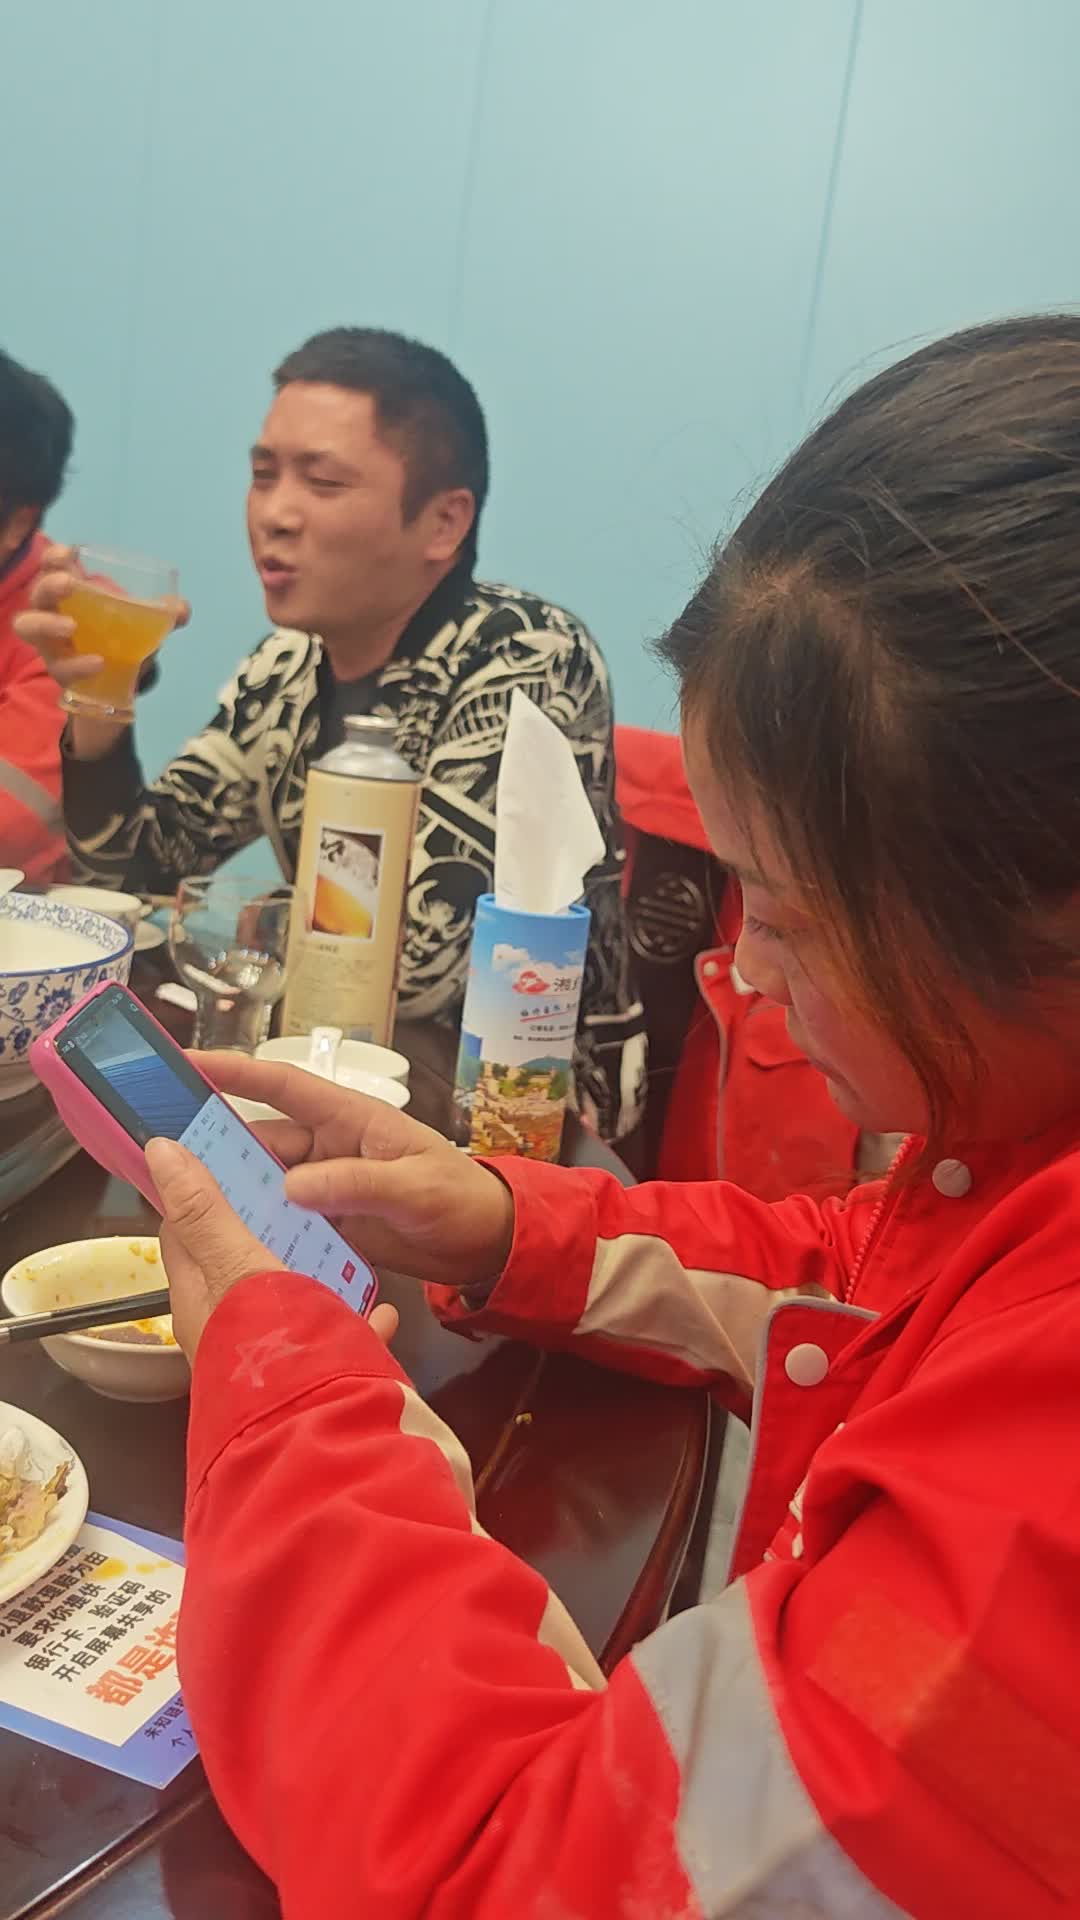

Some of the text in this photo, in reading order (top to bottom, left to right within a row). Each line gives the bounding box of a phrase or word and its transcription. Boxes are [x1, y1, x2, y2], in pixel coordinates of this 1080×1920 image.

[13, 1583, 106, 1648] 要求你提供
[24, 1580, 147, 1671] 银行卡、验证码
[52, 1589, 172, 1683] 开启屏幕共享的
